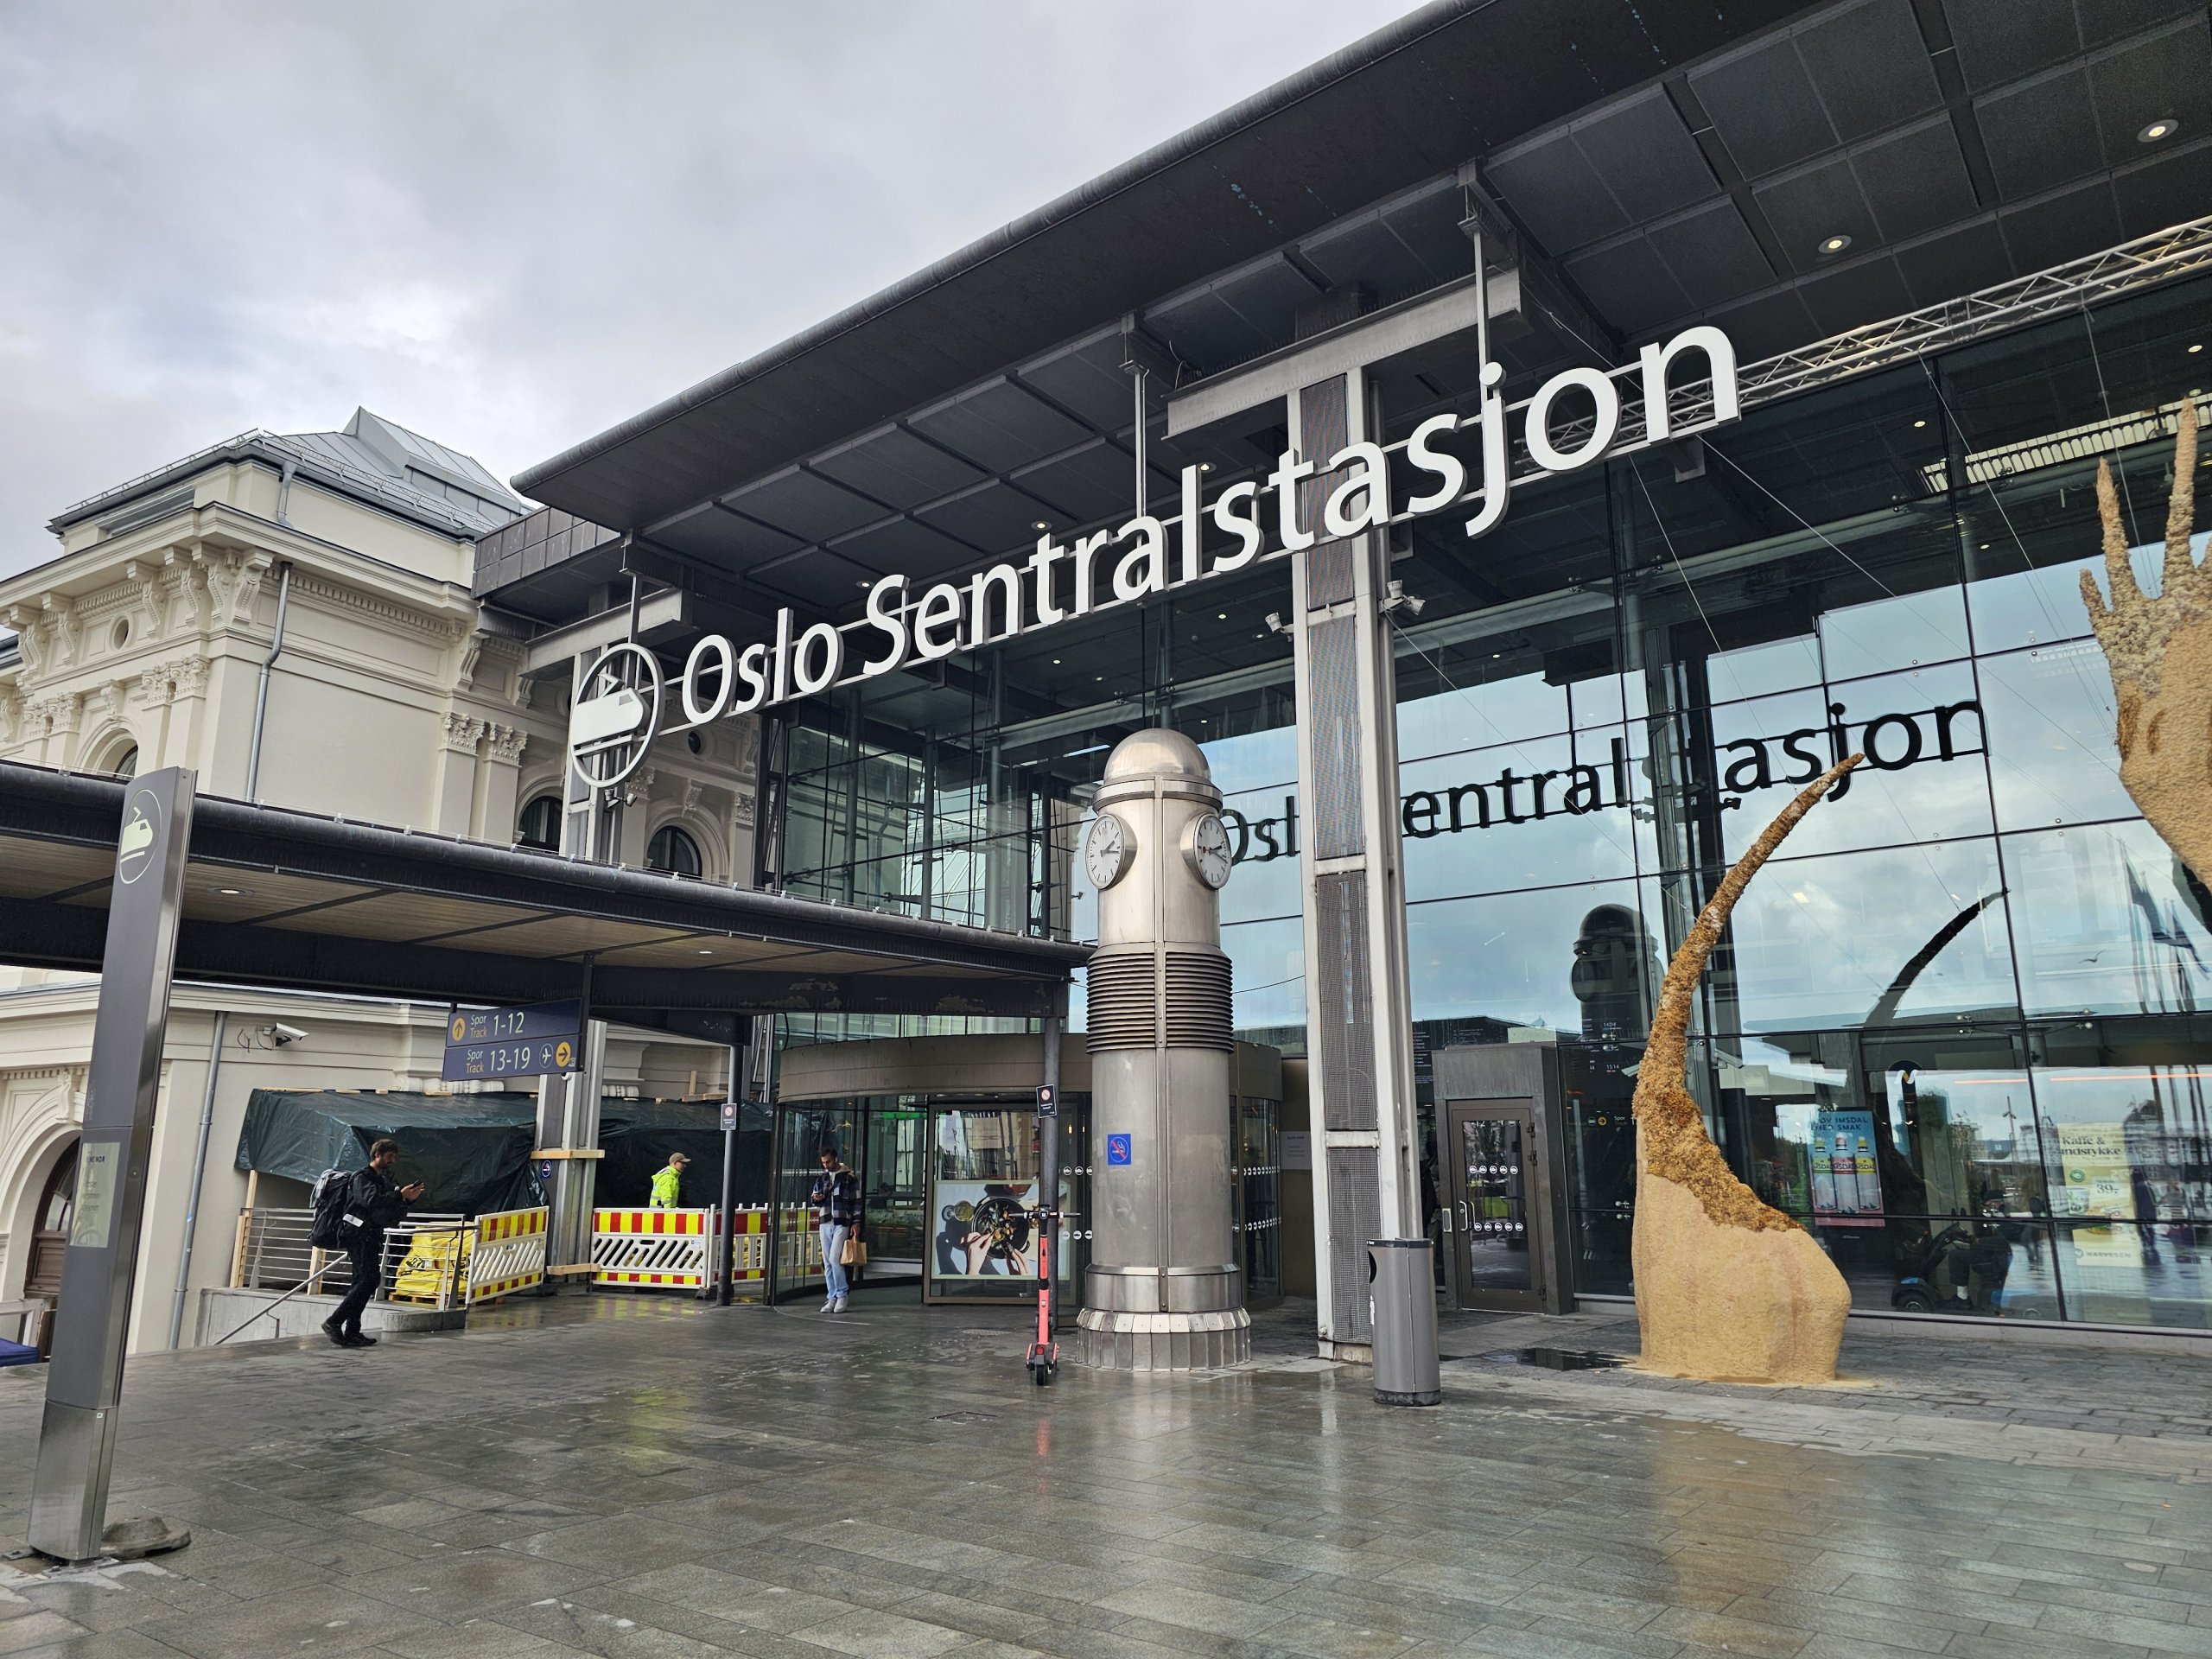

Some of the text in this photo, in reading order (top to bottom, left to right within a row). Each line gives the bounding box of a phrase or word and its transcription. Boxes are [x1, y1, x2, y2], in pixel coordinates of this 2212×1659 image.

[682, 325, 1741, 724] Oslo Sentralstasjon
[470, 1011, 524, 1036] Spor 1-12
[470, 1026, 488, 1039] Track
[466, 1062, 484, 1074] Track
[467, 1046, 531, 1071] Spor 13-19
[2063, 1135, 2106, 1145] Kaffe &
